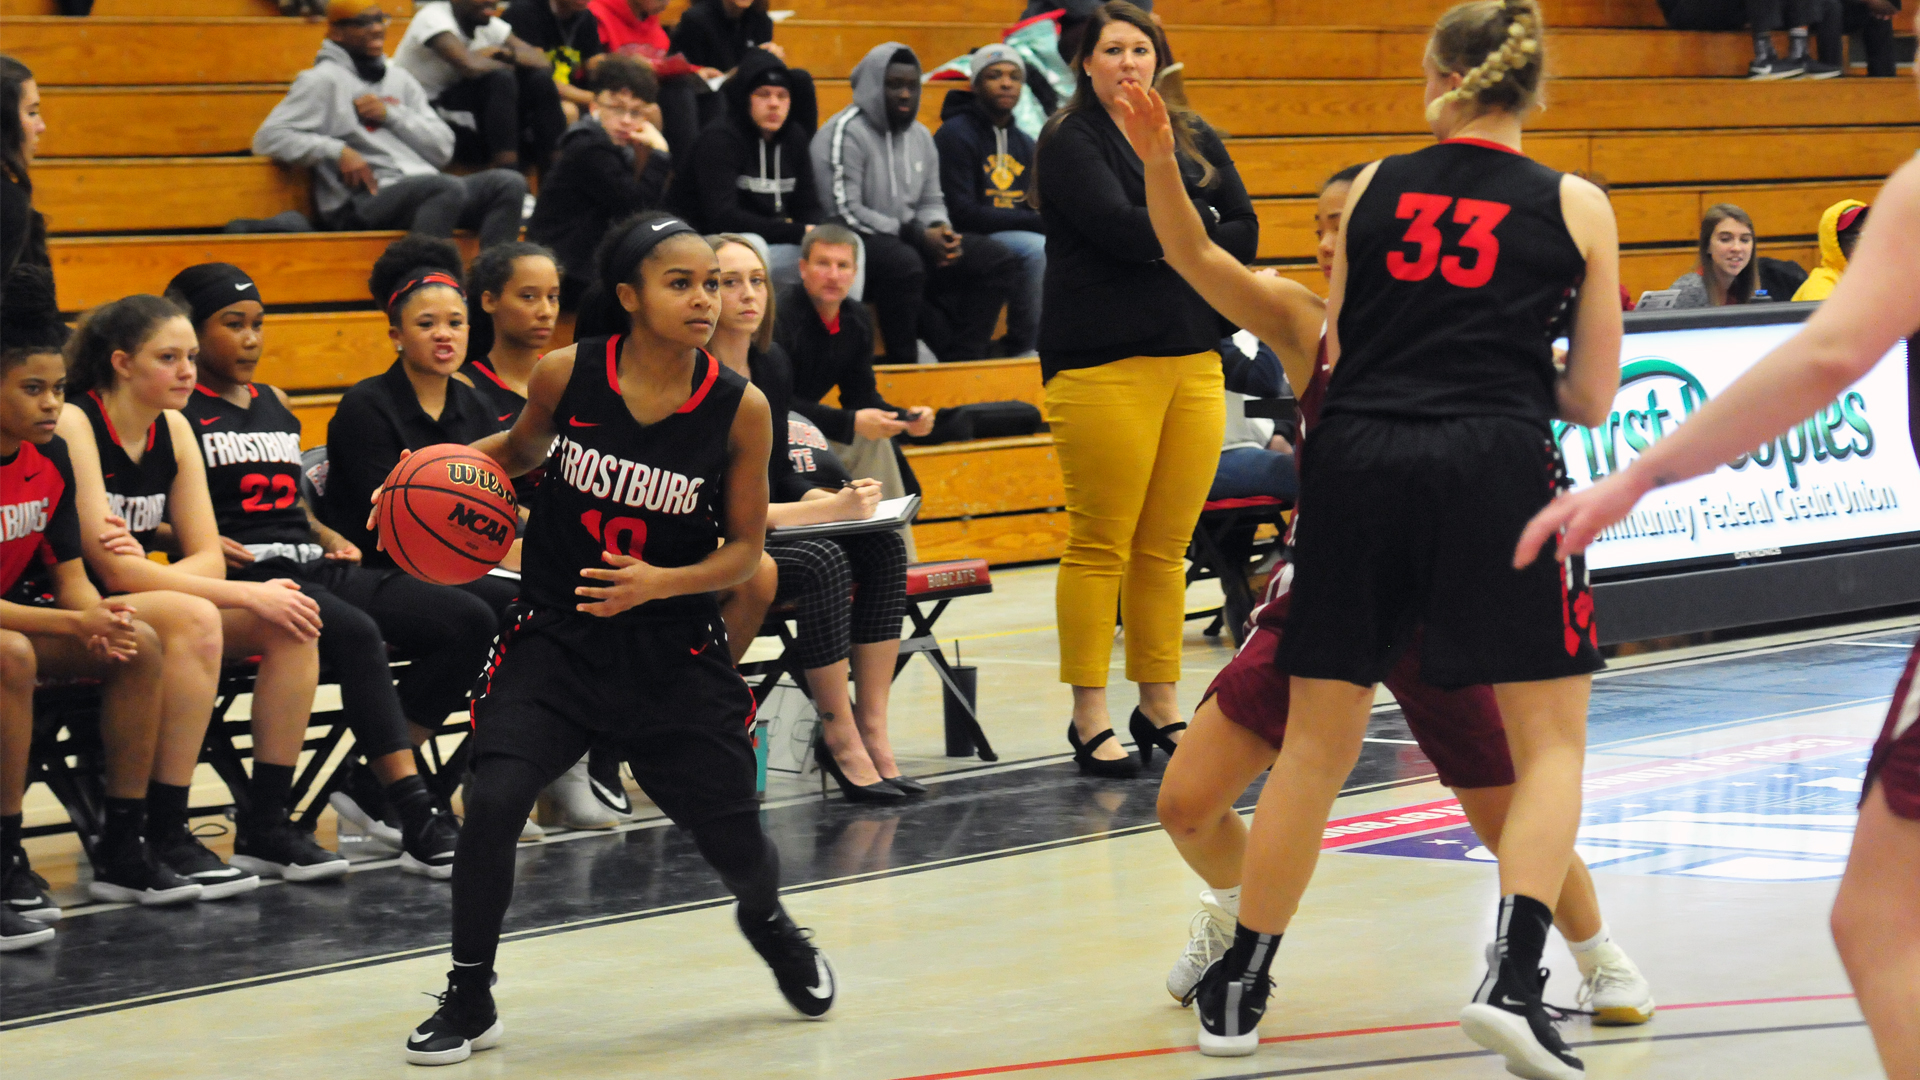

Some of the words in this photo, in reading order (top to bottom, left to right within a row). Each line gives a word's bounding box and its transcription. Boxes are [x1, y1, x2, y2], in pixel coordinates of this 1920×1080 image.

[1386, 192, 1512, 288] 33
[202, 431, 303, 468] FROSTBUR
[1550, 388, 1670, 482] irst
[789, 448, 817, 473] TE
[447, 502, 508, 546] NCAA
[1592, 500, 1695, 541] mmunity
[1699, 488, 1774, 530] Federal
[1774, 484, 1837, 521] Credit
[1833, 480, 1899, 515] Union
[927, 569, 976, 588] BOBCATS
